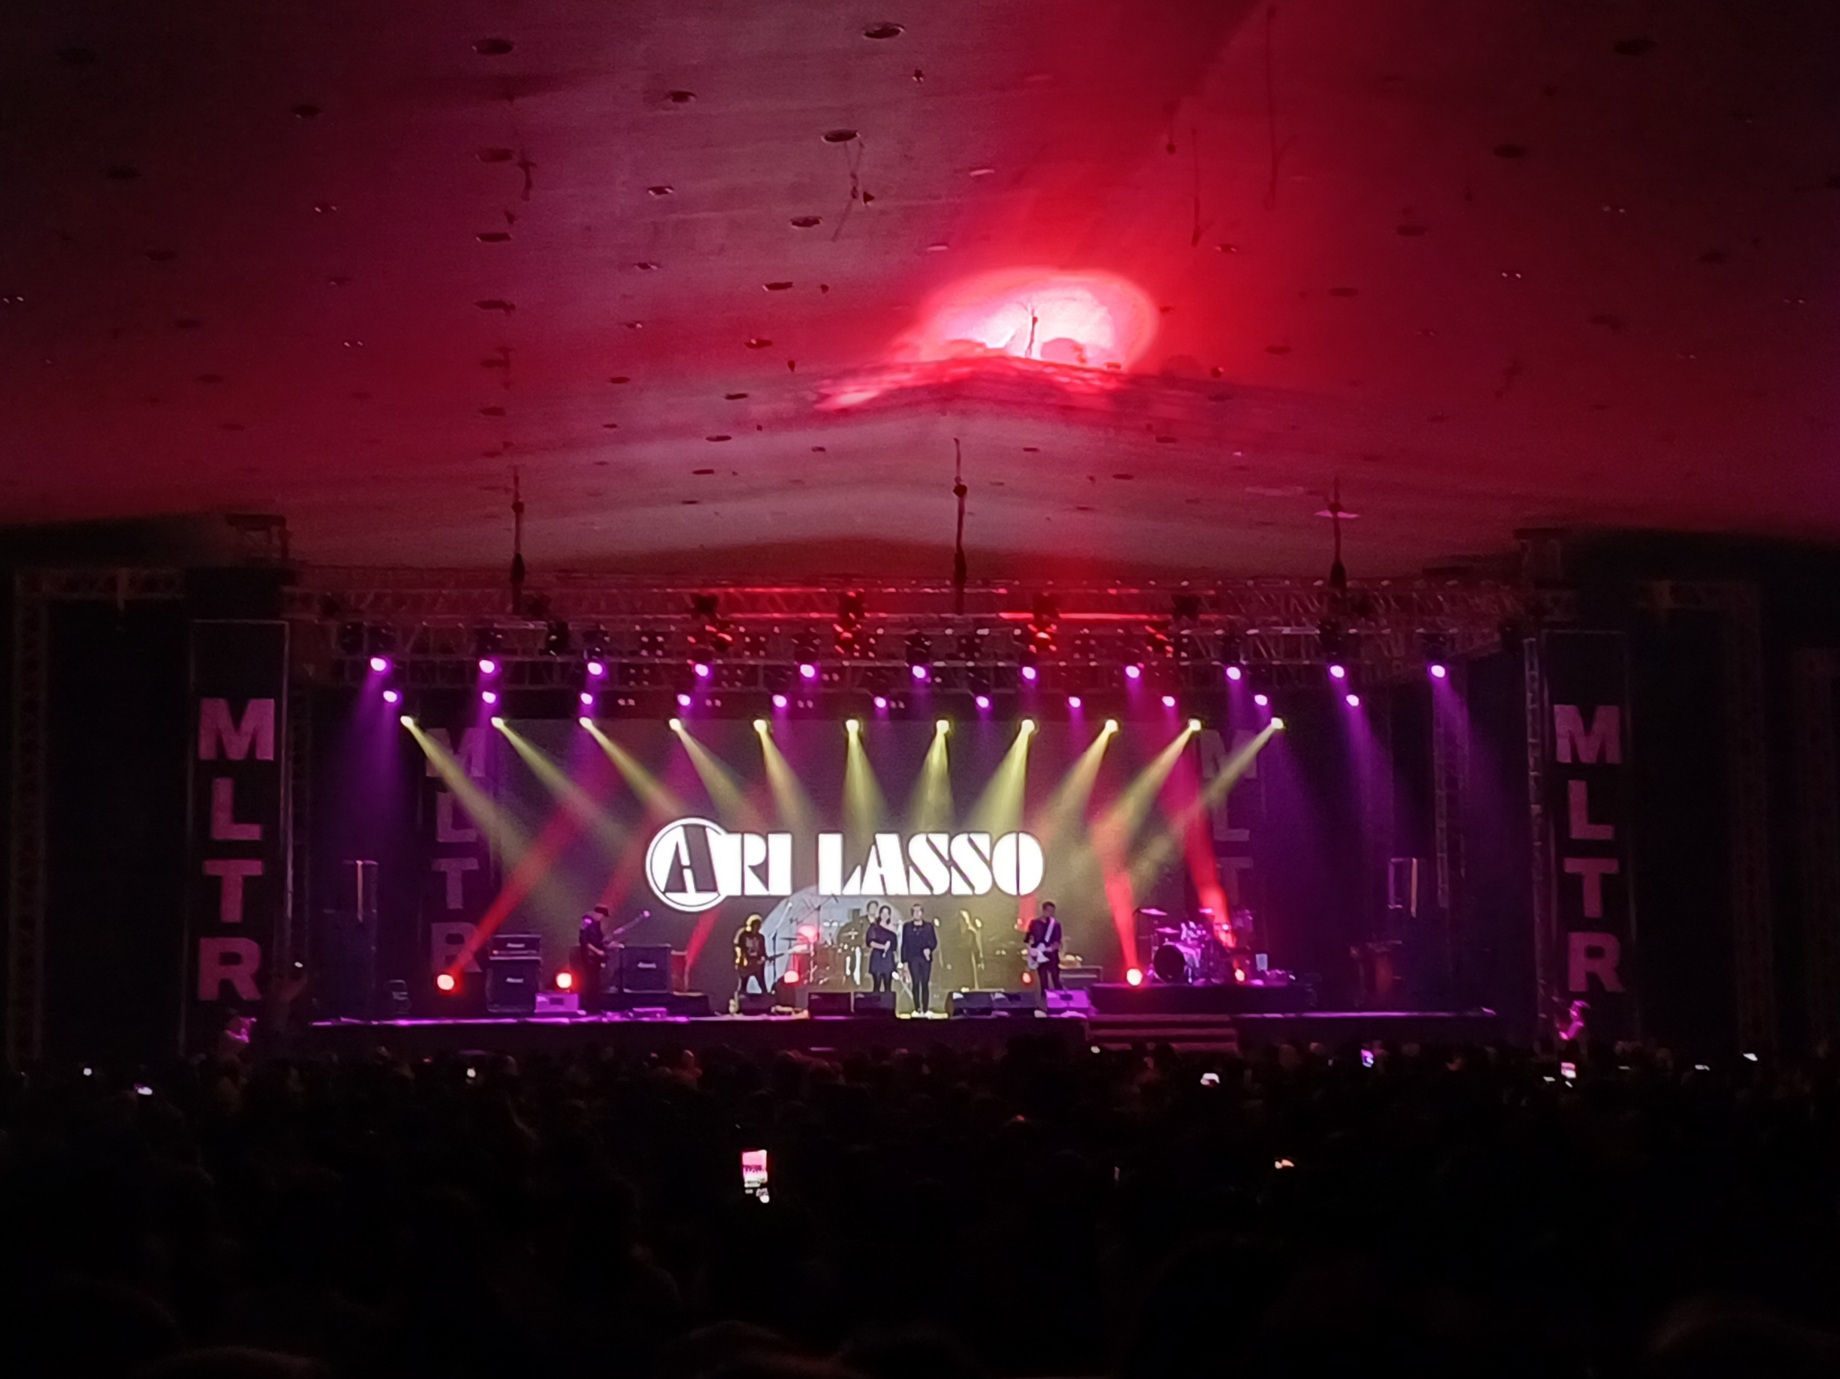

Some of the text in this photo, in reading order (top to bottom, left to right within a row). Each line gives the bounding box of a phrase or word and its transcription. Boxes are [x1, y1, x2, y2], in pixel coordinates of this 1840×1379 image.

[197, 697, 275, 1001] MLTR
[645, 817, 1044, 912] ARI LASSO
[1553, 704, 1626, 993] MLTR
